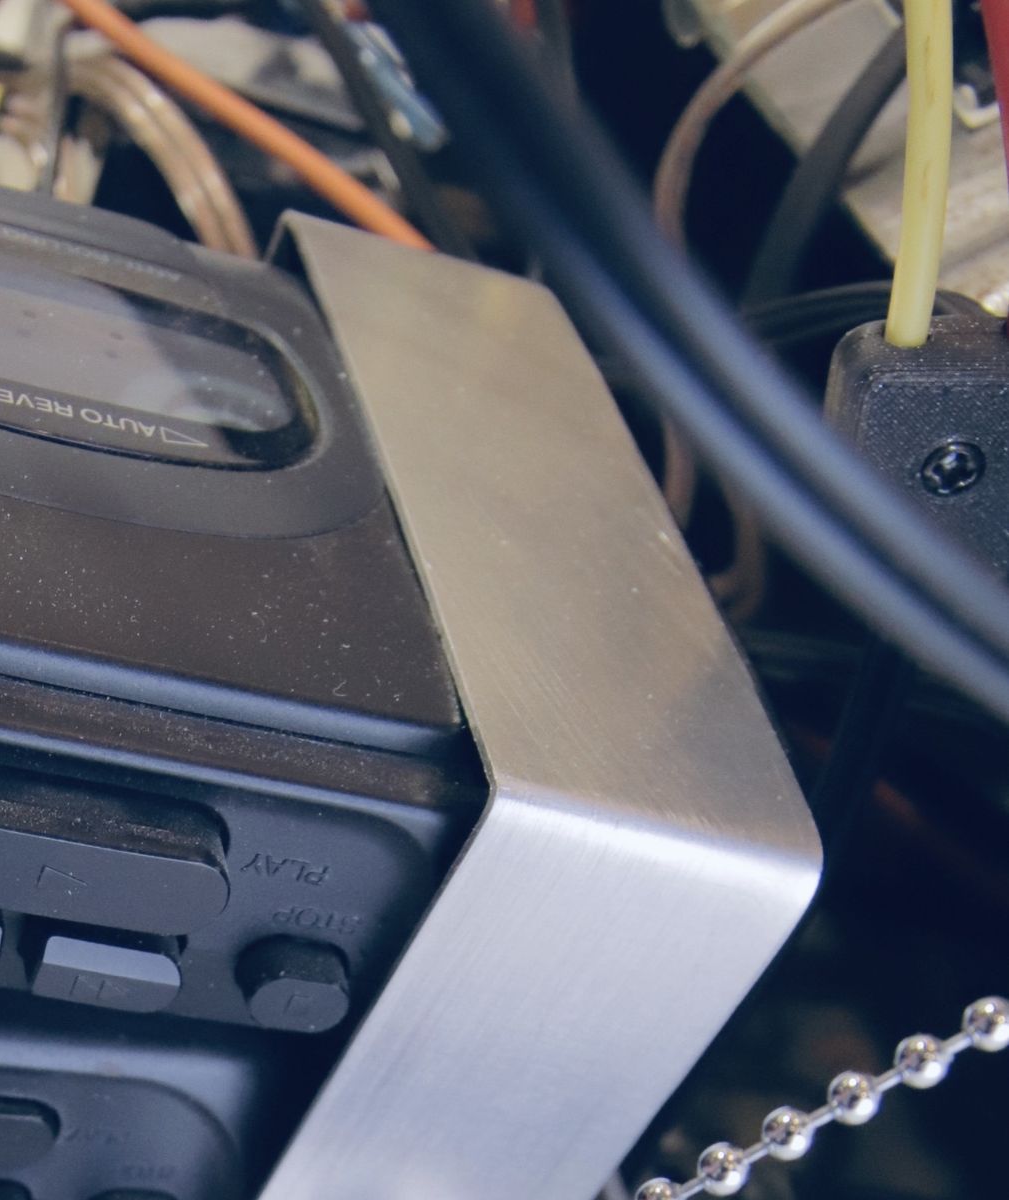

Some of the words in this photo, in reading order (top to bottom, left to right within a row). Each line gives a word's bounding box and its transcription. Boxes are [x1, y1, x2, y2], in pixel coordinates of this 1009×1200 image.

[80, 407, 157, 438] AUTO
[239, 853, 330, 887] PLAY
[271, 906, 361, 935] STOP
